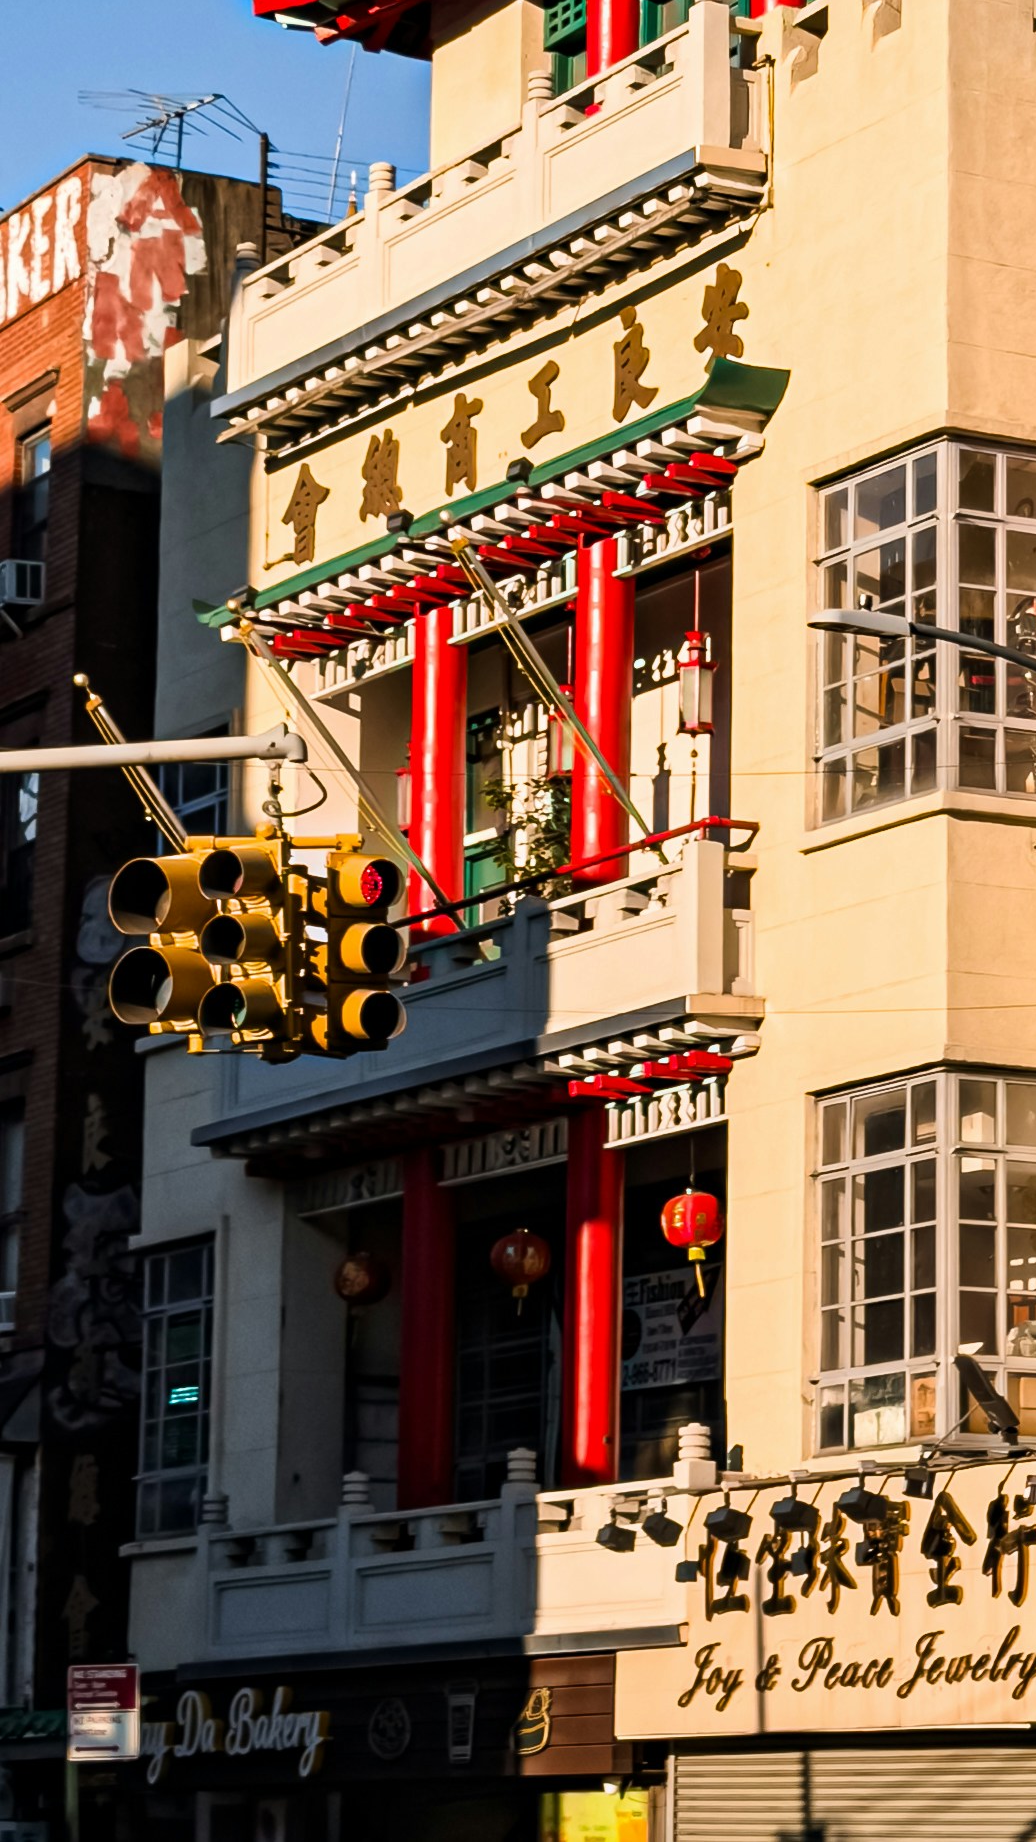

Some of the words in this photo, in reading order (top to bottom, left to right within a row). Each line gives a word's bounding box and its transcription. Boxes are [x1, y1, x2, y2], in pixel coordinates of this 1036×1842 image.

[677, 1642, 743, 1711] Joy
[755, 1654, 782, 1692] &
[791, 1636, 894, 1692] Peace
[173, 1690, 218, 1757] Da
[224, 1686, 330, 1777] Bakery
